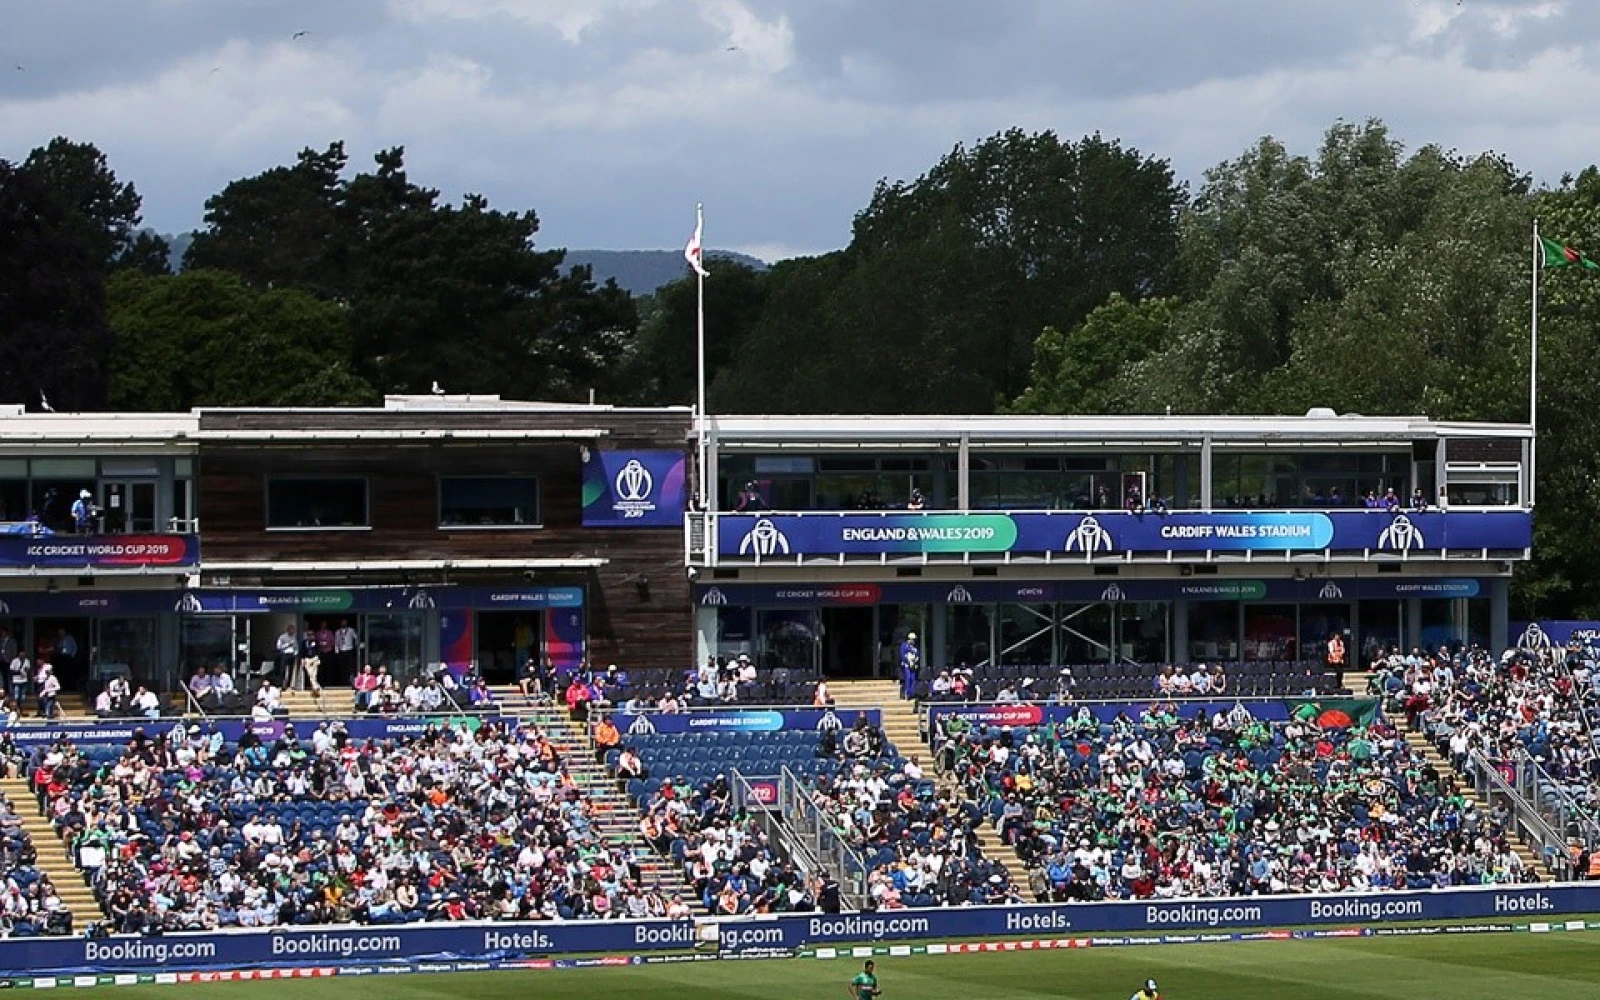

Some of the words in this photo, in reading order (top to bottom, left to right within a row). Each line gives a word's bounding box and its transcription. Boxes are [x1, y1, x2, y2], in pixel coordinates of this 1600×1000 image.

[843, 528, 905, 541] ENGLAND
[907, 528, 917, 541] &
[1161, 526, 1213, 538] CARDIFF
[1215, 525, 1256, 537] WALES
[1259, 525, 1311, 537] STADIUM
[45, 545, 84, 555] CRICKET
[87, 545, 124, 555] WORLD
[126, 545, 145, 555] CUP
[147, 544, 169, 554] 2019
[1311, 899, 1422, 919] Booking.com
[1495, 893, 1553, 911] Hotels.
[1008, 913, 1070, 930] Hotels.
[1147, 904, 1260, 925] Booking.com
[810, 916, 928, 936] Booking.com
[273, 935, 400, 956] Booking.com
[485, 931, 553, 949] Hotels.
[86, 941, 215, 962] Booking.com
